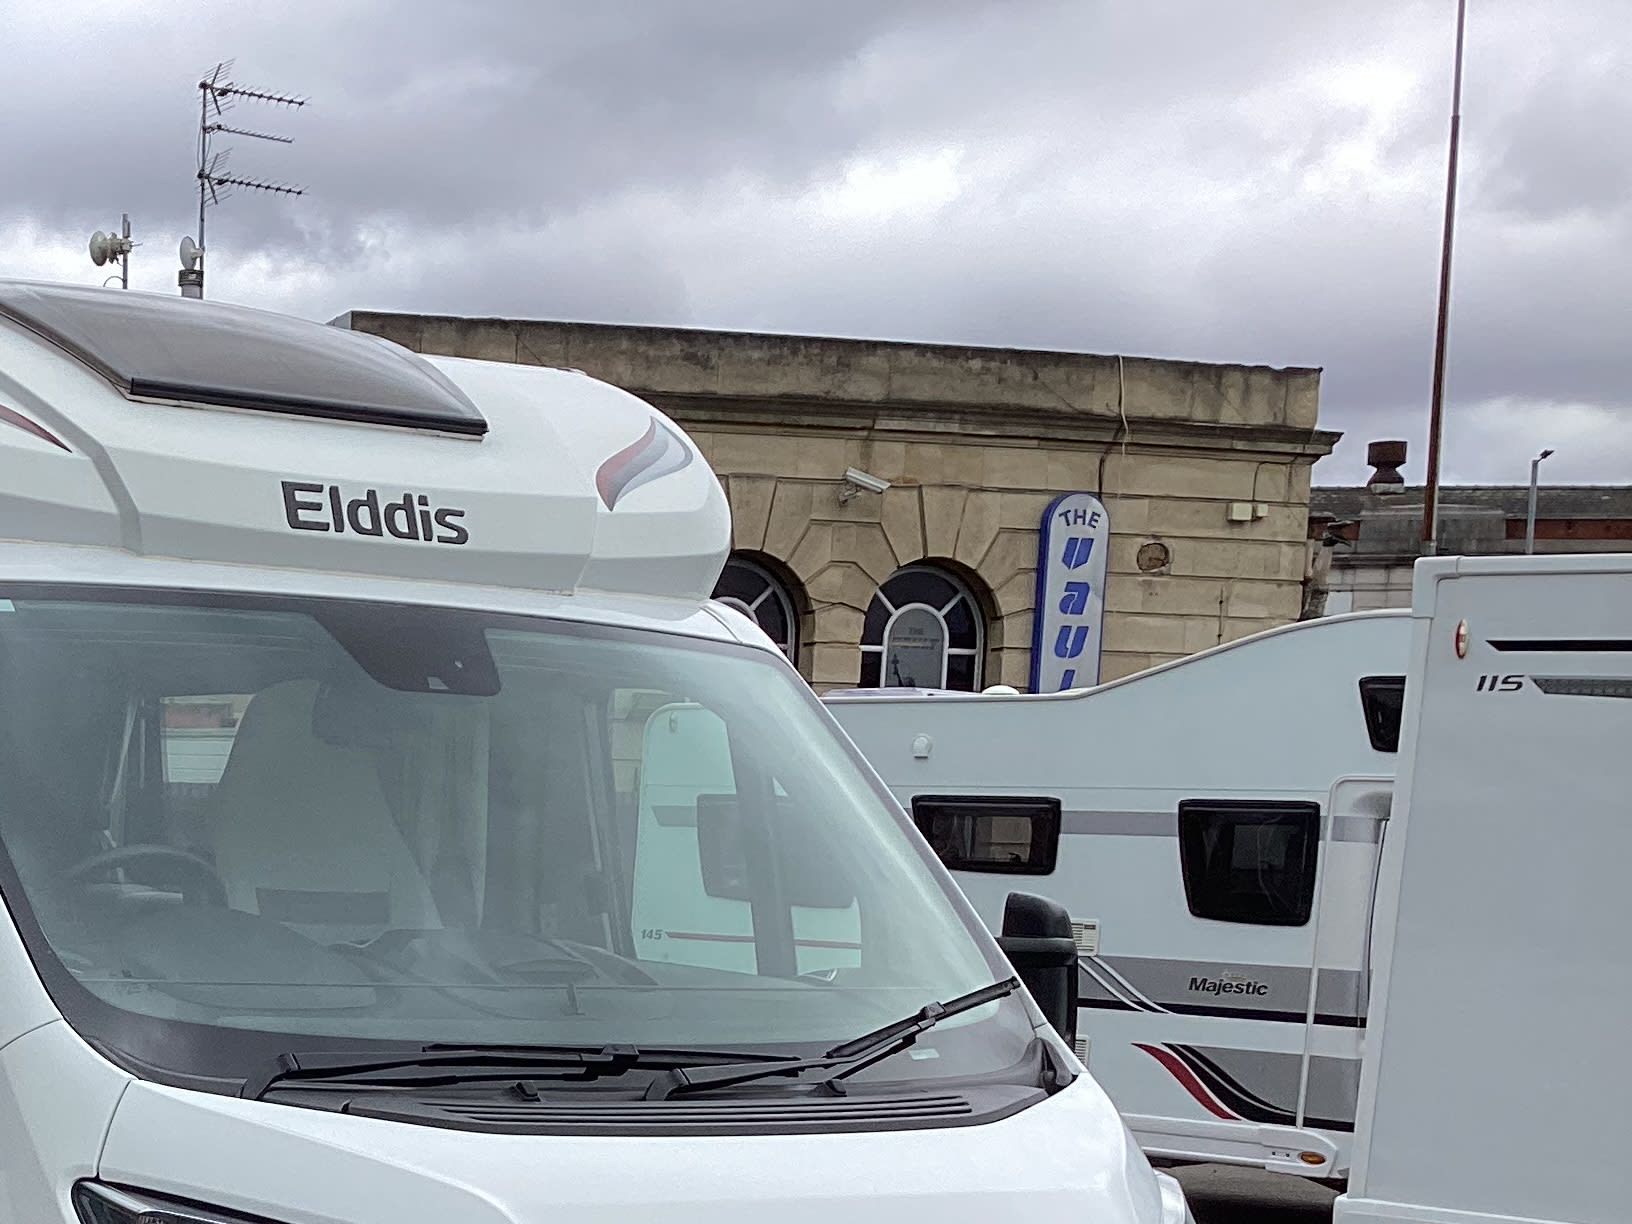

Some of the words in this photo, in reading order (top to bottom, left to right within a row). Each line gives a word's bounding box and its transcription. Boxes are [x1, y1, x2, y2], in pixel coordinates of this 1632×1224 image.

[280, 480, 469, 545] Elddis
[1058, 508, 1102, 530] THE
[1188, 977, 1268, 996] Majestic
